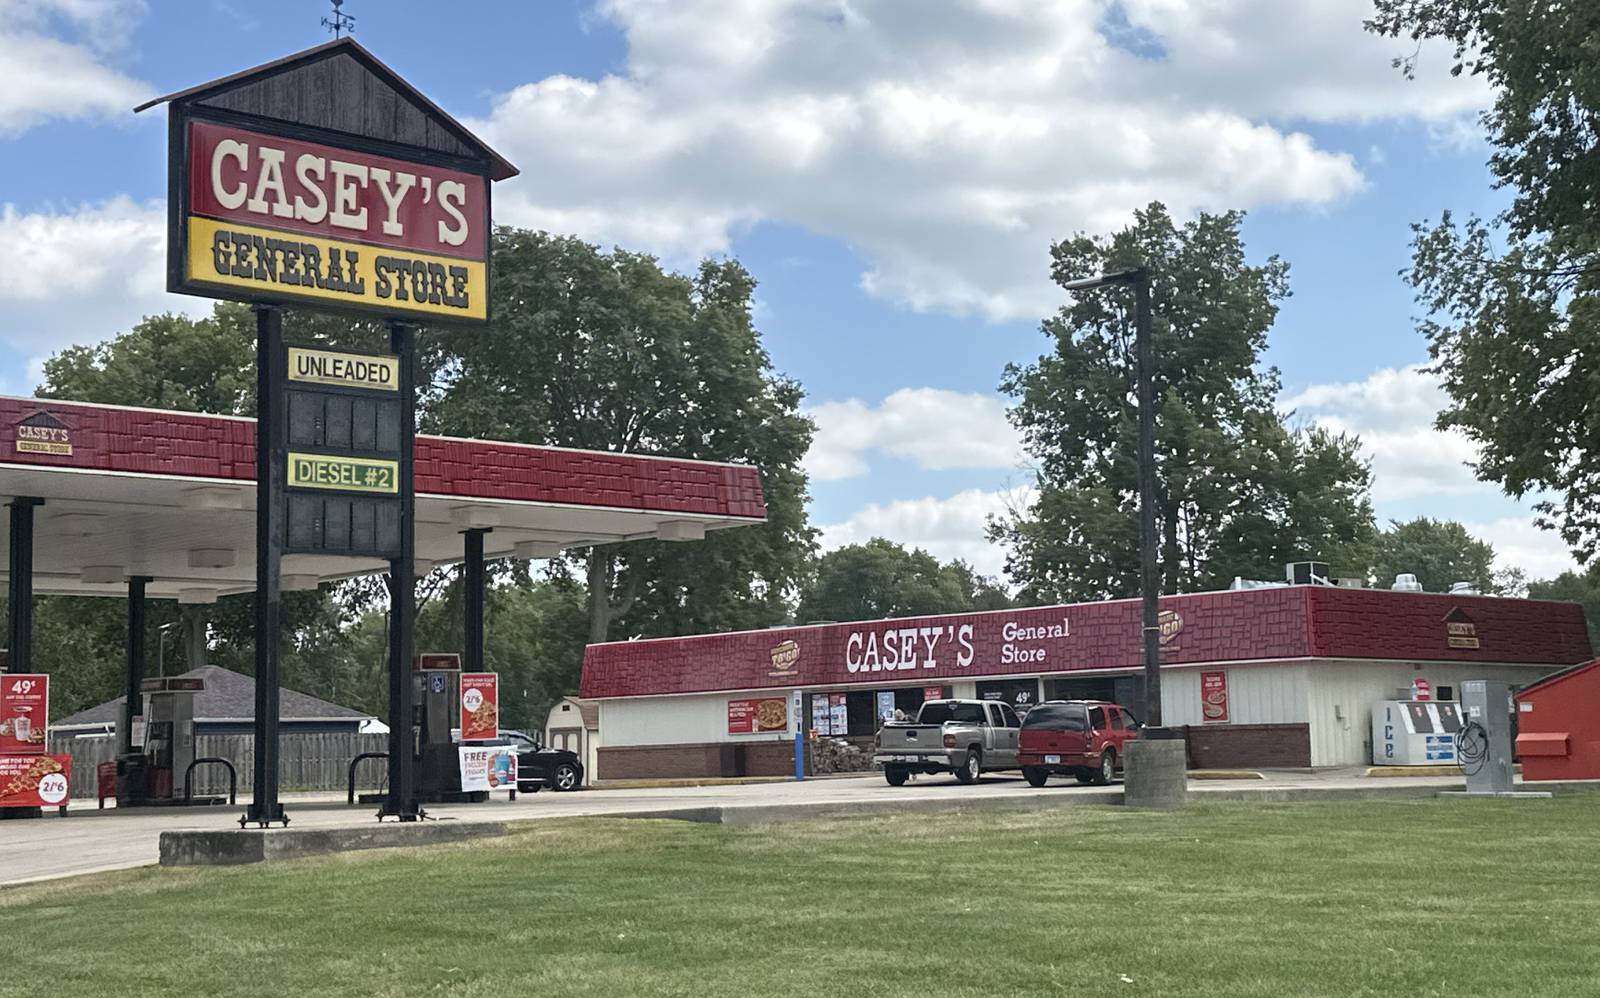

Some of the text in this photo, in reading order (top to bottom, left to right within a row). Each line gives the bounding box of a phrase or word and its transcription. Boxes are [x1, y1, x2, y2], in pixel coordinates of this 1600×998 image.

[212, 139, 469, 246] CASEY'S
[213, 231, 469, 308] GENERAL STORE
[298, 355, 391, 383] UNLEADED
[18, 426, 69, 441] CASEY'S
[299, 461, 389, 487] DIESEL #2
[846, 618, 1070, 673] CASEY'S General
[1001, 643, 1047, 664] Store
[464, 752, 487, 761] FREE
